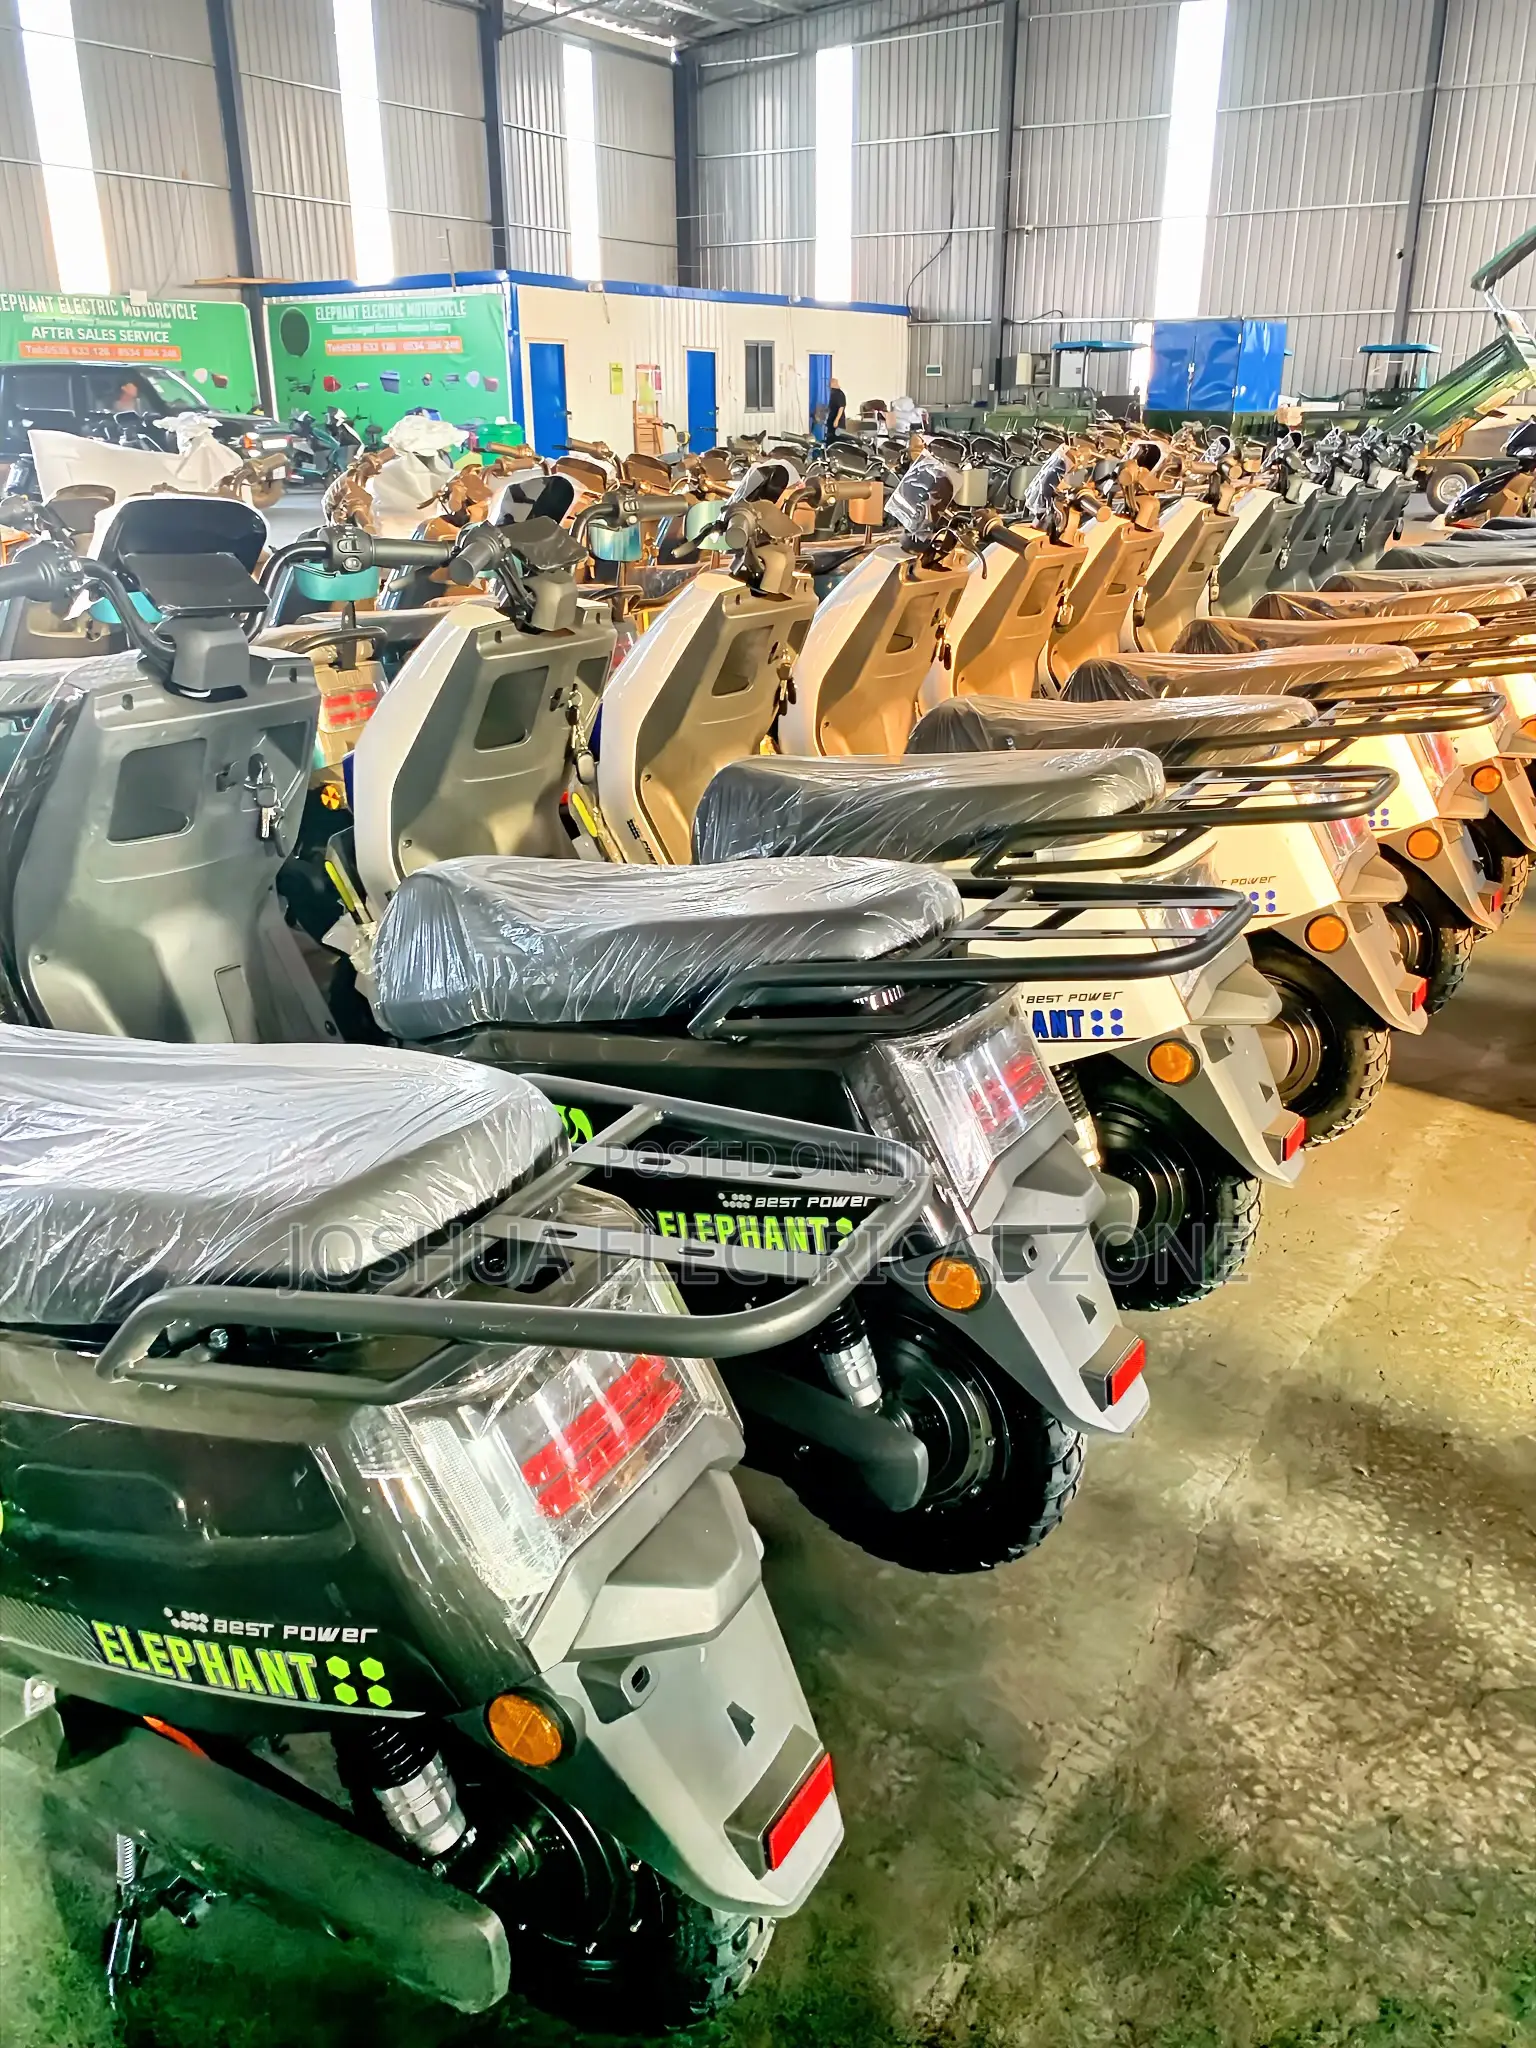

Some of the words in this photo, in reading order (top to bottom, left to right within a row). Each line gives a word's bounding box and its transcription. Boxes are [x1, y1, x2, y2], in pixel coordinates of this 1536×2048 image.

[0, 294, 53, 312] EPHANT
[58, 297, 118, 316] ELECTRIC
[122, 300, 198, 320] MOTORCYCLE
[32, 326, 74, 340] AFTER
[78, 328, 116, 341] SALES
[119, 329, 169, 343] SERVICE
[1230, 876, 1276, 886] POWER
[1027, 995, 1063, 1004] BEST
[1068, 991, 1123, 1003] POWER
[754, 1196, 801, 1208] BEST
[806, 1195, 876, 1208] POWER
[213, 1619, 275, 1639] BEST
[283, 1625, 378, 1643] POWER
[91, 1619, 321, 1702] ELEPHANT
